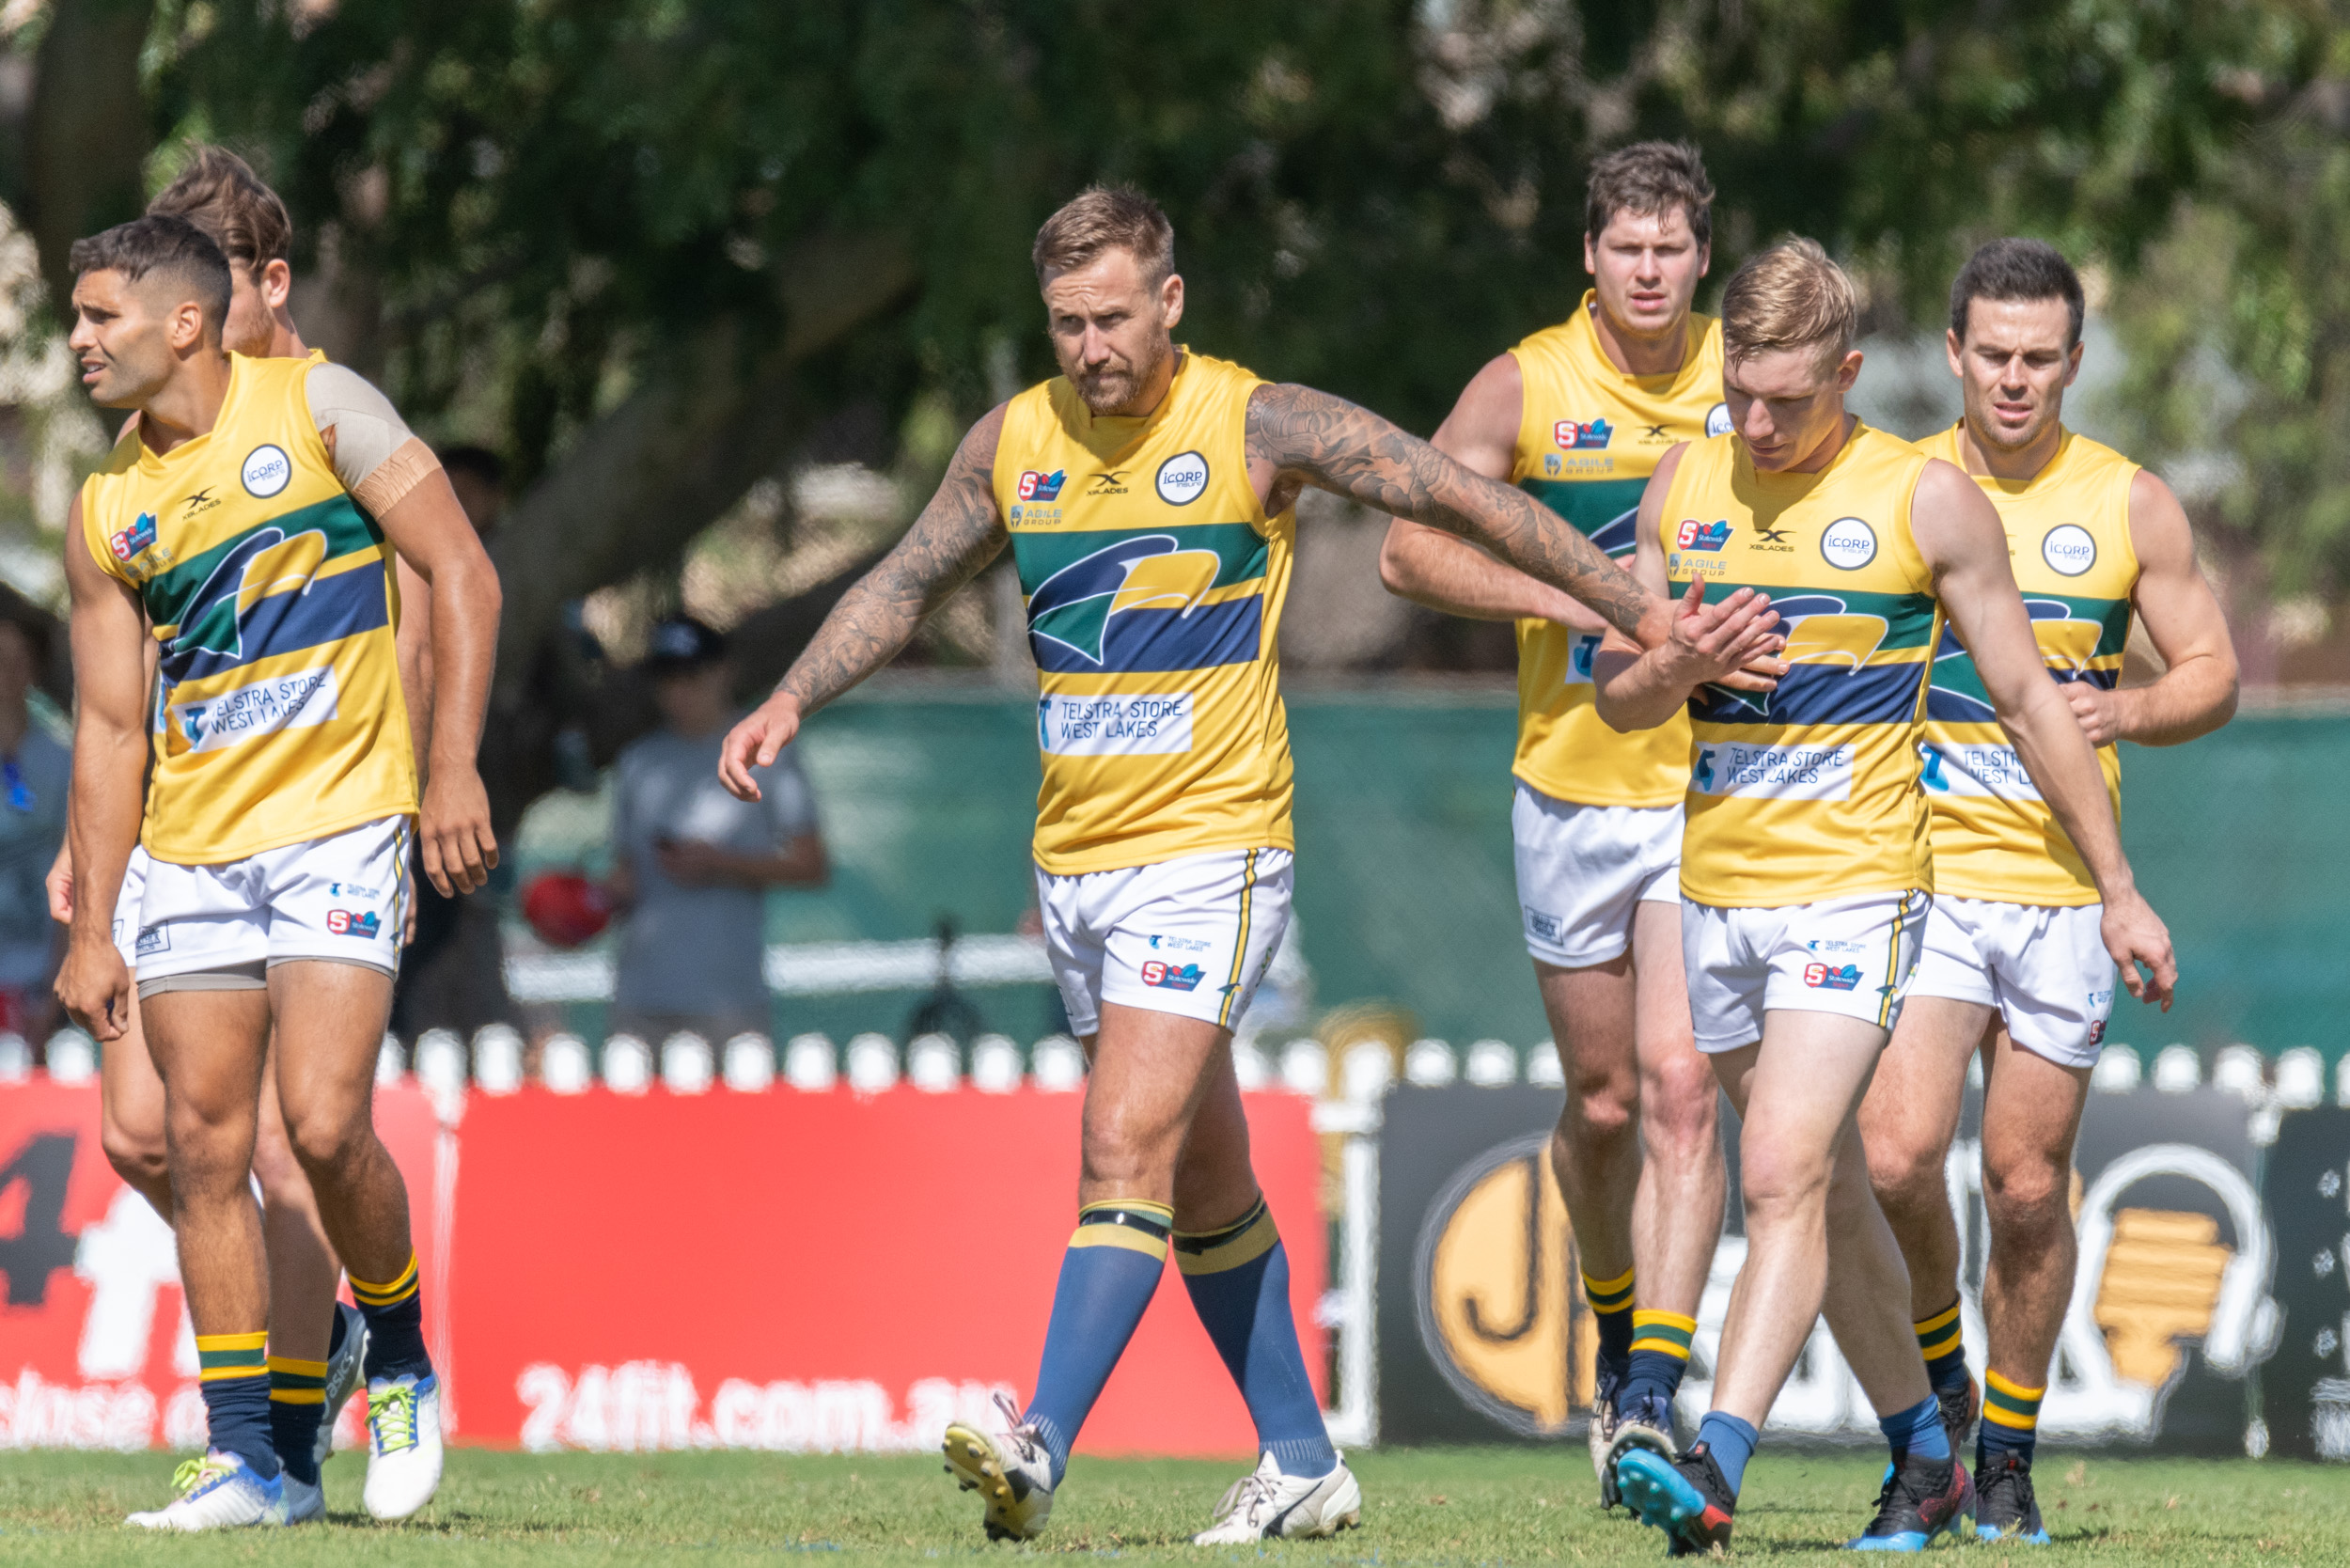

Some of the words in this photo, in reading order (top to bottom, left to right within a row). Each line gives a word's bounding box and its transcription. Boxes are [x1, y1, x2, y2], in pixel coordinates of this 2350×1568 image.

[1164, 471, 1202, 484] iCORP
[1086, 487, 1128, 496] XBLADES
[1025, 509, 1062, 518] AGILE
[1748, 543, 1794, 553] XBLADES
[1826, 534, 1870, 549] iCORP
[2049, 541, 2090, 555] iCORP
[1683, 558, 1728, 570] AGILE
[279, 671, 326, 699] STORE
[1062, 701, 1122, 720] TELSTRA
[1130, 699, 1184, 719] STORE
[211, 710, 255, 735] WEST
[1061, 721, 1101, 740] WEST
[1106, 720, 1158, 738] LAKES
[1729, 747, 1787, 766] TELSTRA
[1793, 750, 1845, 767] STORE
[1964, 750, 2022, 767] TELSTR
[1727, 766, 1766, 784] WEST
[1767, 767, 1819, 785] LAKES
[1827, 974, 1856, 984] Statewide
[326, 1351, 354, 1399] asics
